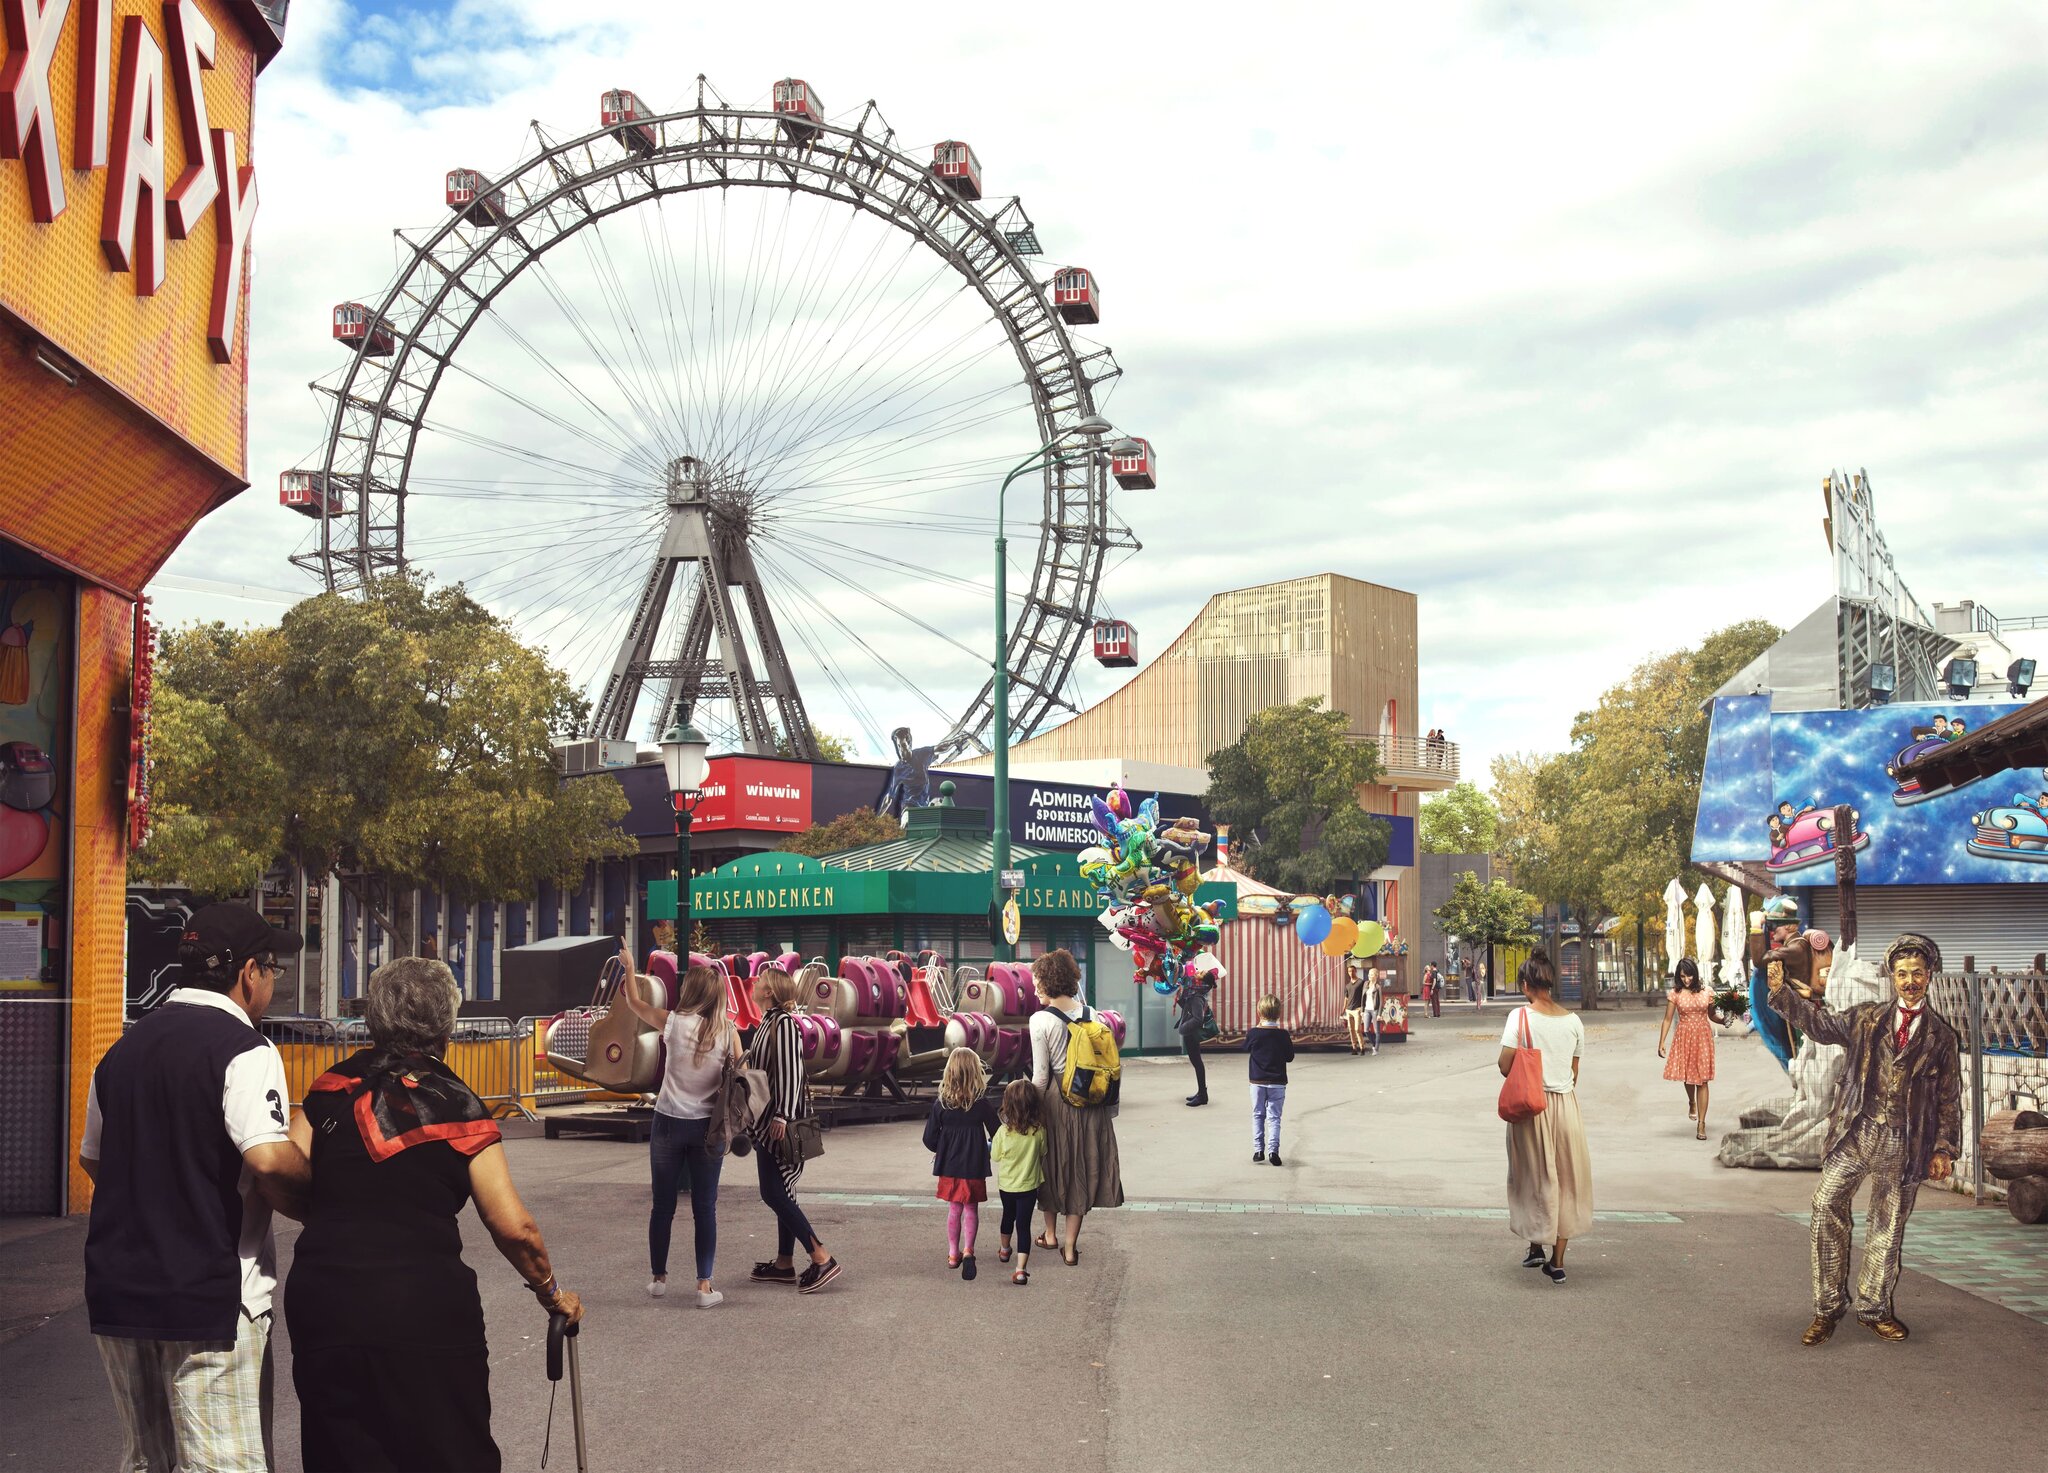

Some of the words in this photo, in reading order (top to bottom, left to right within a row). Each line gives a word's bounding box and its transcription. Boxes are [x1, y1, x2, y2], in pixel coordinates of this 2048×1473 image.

[1029, 788, 1098, 809] ADMIRA
[1036, 809, 1093, 824] SPORTSBA
[695, 886, 834, 911] REISEANDENKEN
[1013, 888, 1107, 909] EISEANDE
[266, 1089, 285, 1127] 3
